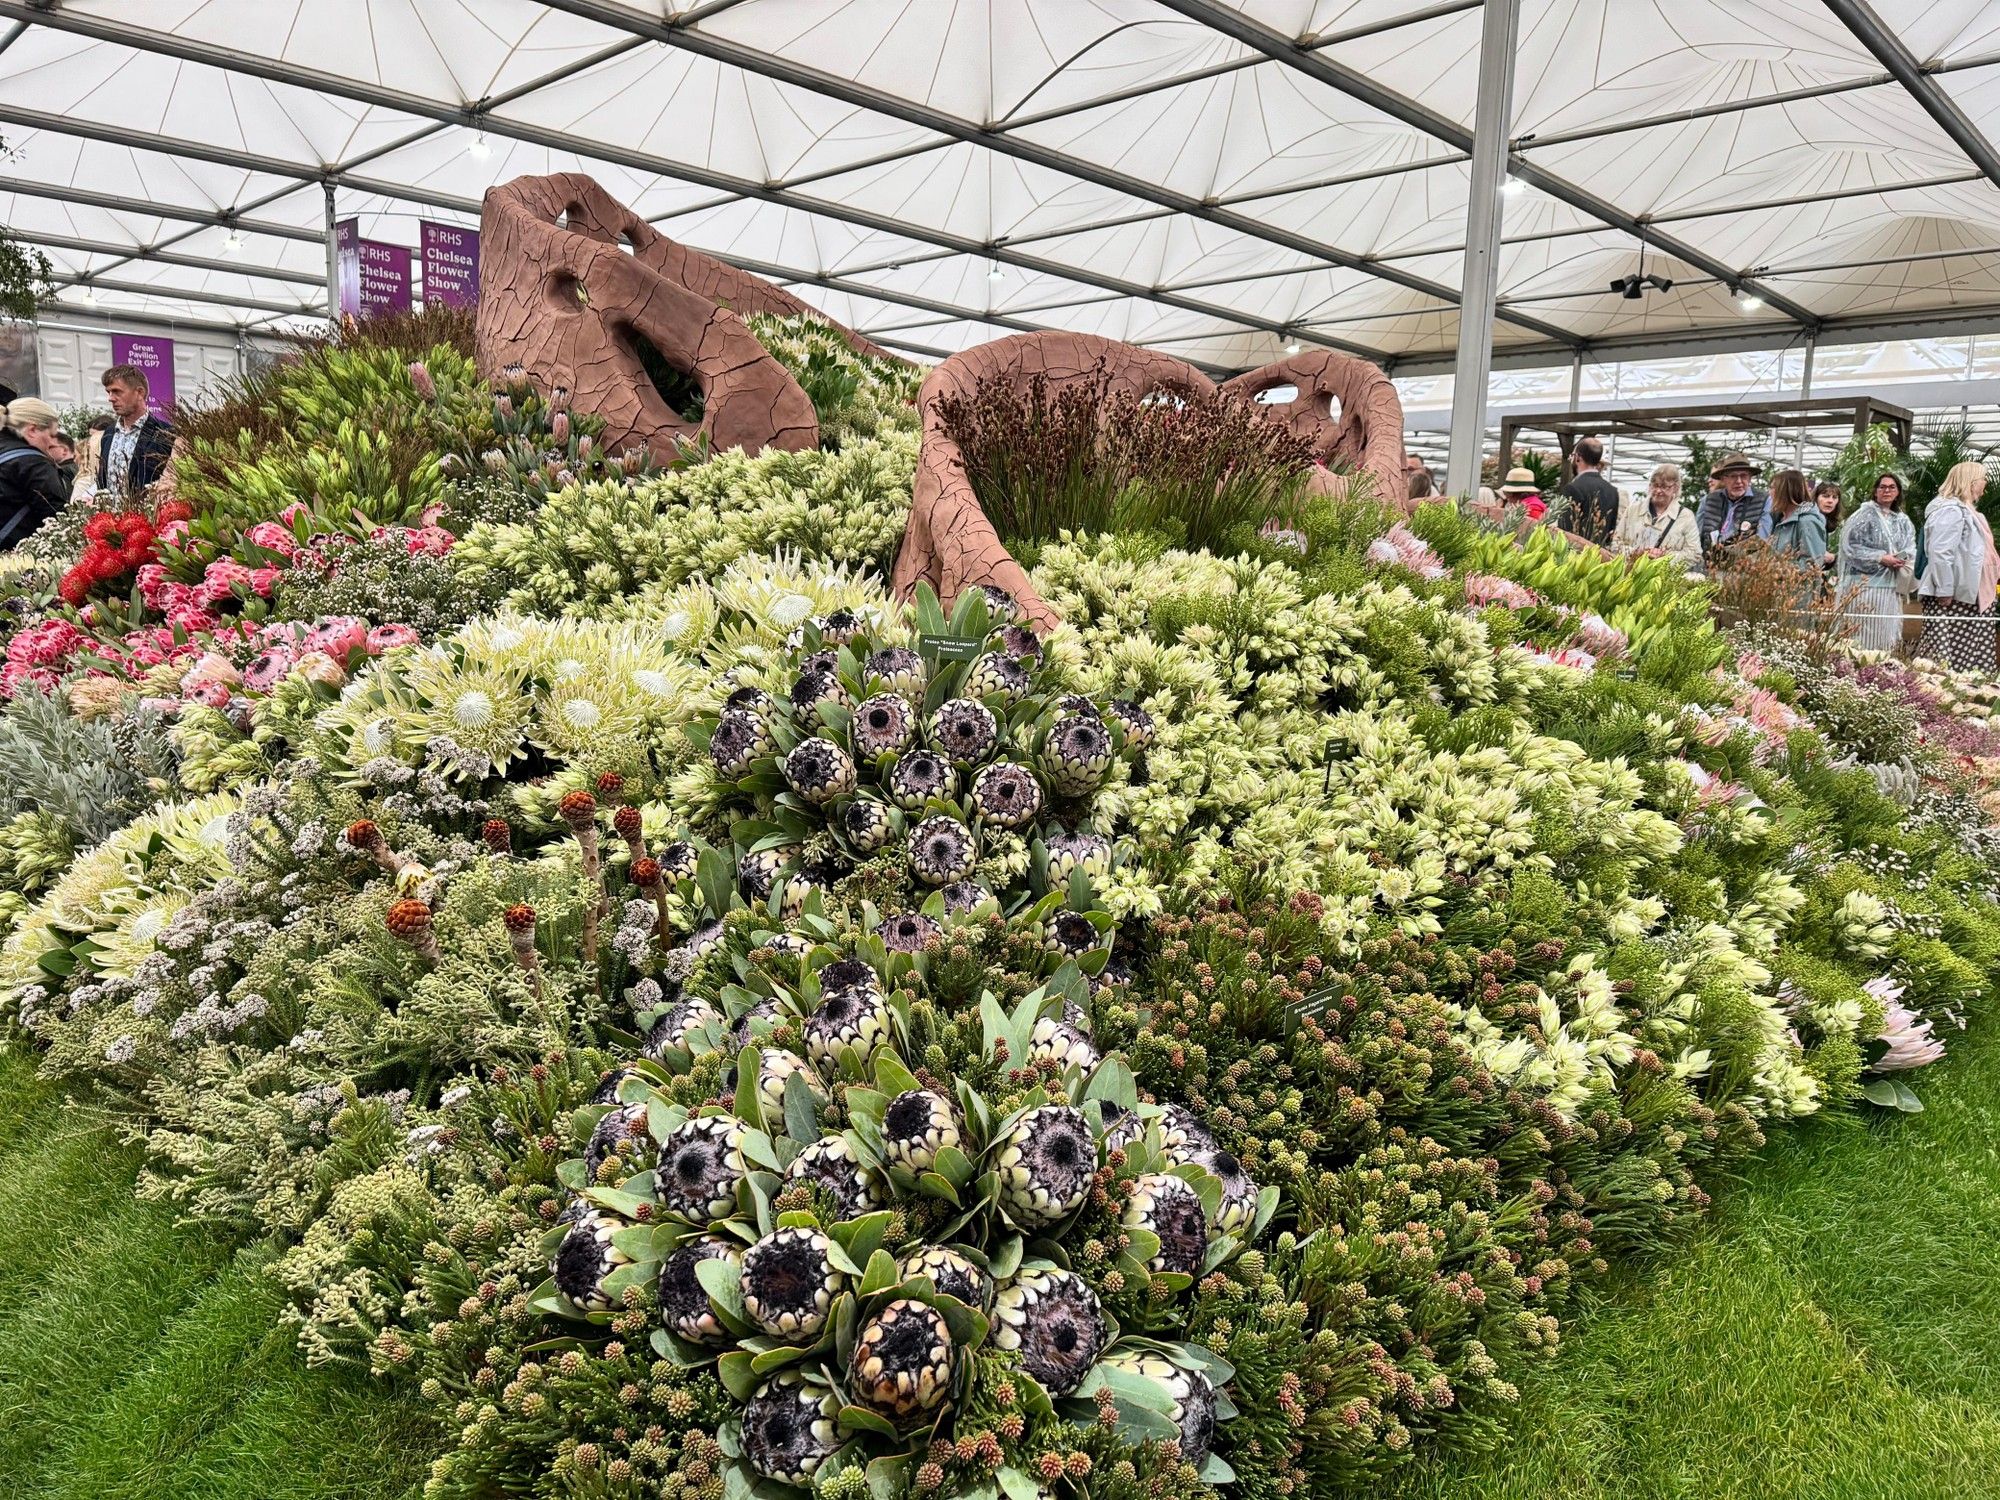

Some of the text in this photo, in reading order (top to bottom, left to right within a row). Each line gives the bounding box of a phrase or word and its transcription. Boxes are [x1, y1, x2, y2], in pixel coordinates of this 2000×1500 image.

[440, 230, 462, 246] RHS
[370, 250, 391, 262] RHS
[427, 247, 473, 266] Chelsea
[359, 264, 402, 281] Chelsea
[427, 261, 470, 279] Flower
[359, 278, 398, 293] Flower
[427, 275, 461, 291] Show
[128, 350, 159, 360] Pavilion
[132, 343, 154, 352] Great
[128, 358, 160, 368] Exit GP7
